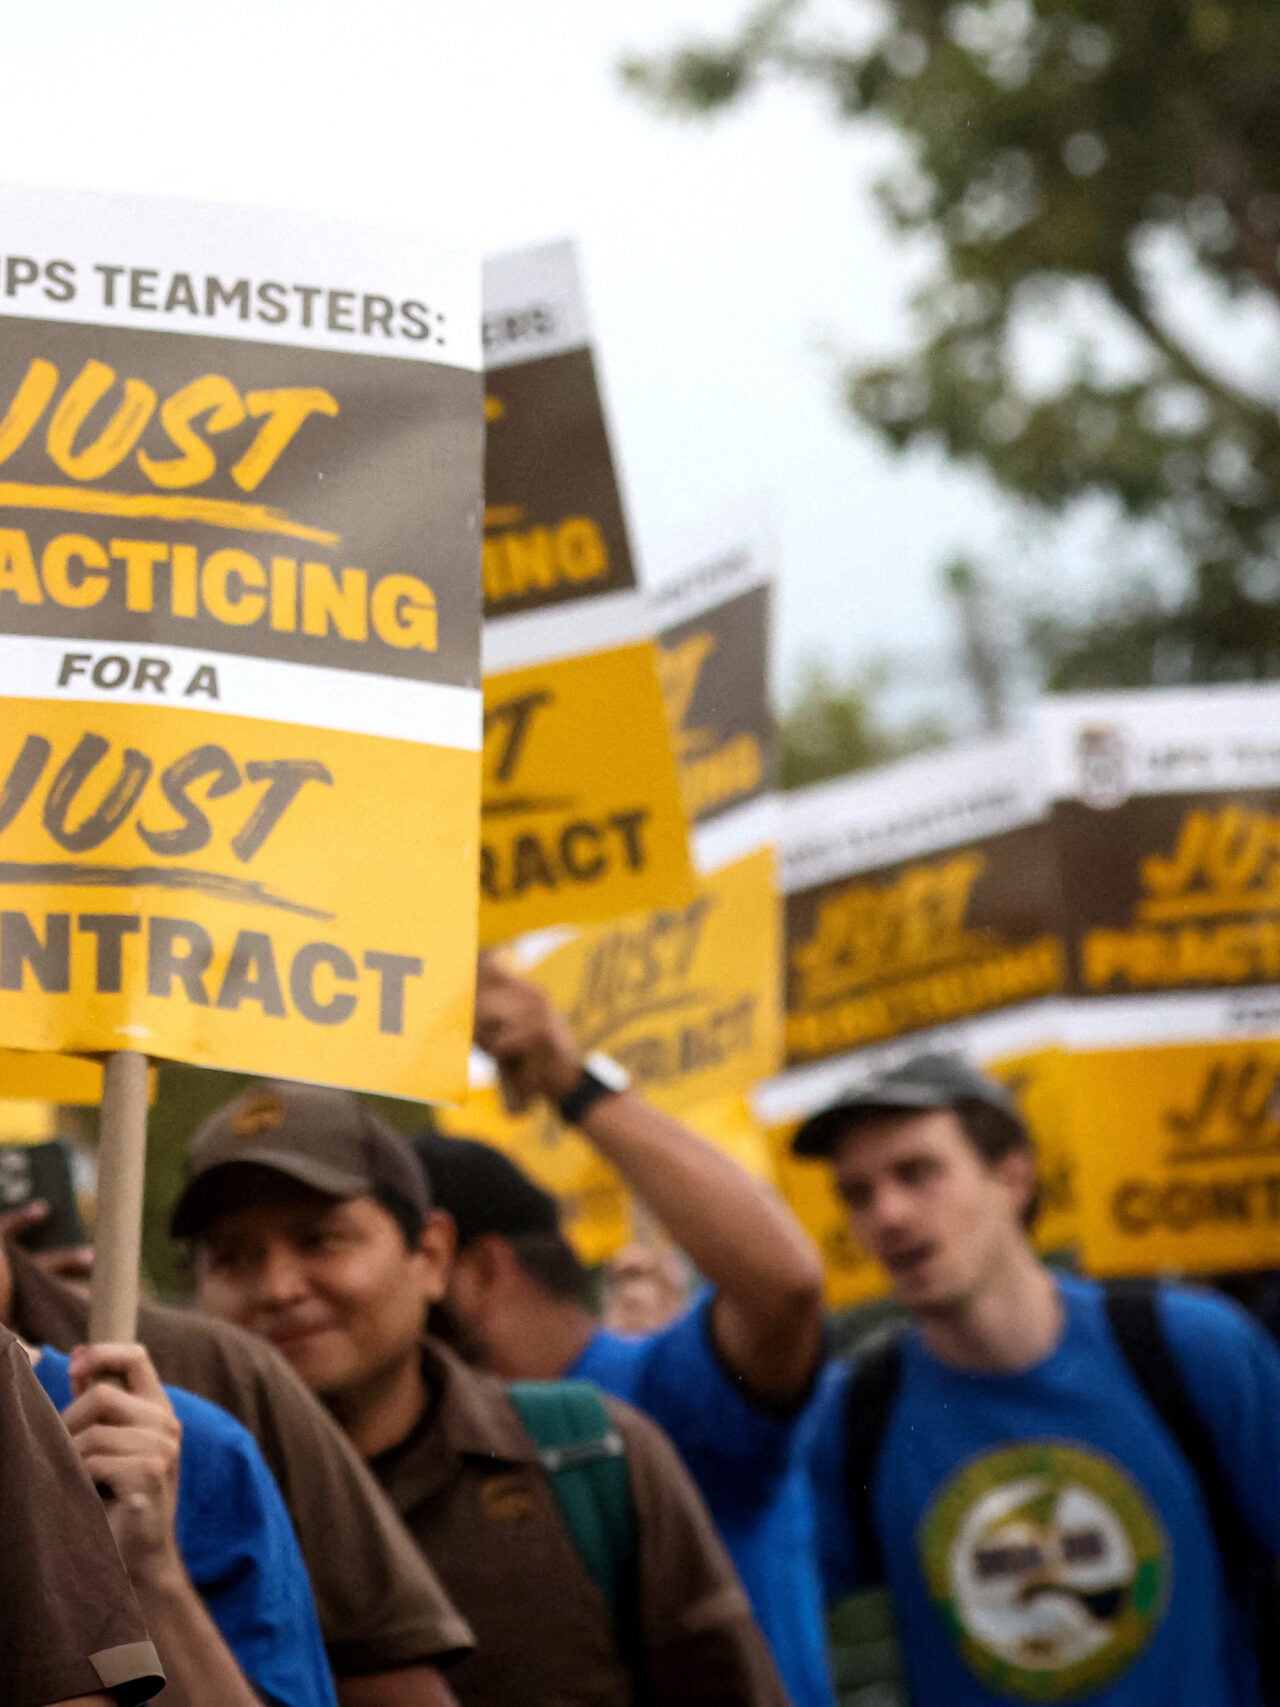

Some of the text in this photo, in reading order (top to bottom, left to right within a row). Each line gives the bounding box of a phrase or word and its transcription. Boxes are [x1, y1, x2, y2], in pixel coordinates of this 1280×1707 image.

[93, 264, 446, 345] TEAMSTERS:
[57, 652, 221, 699] FOR A
